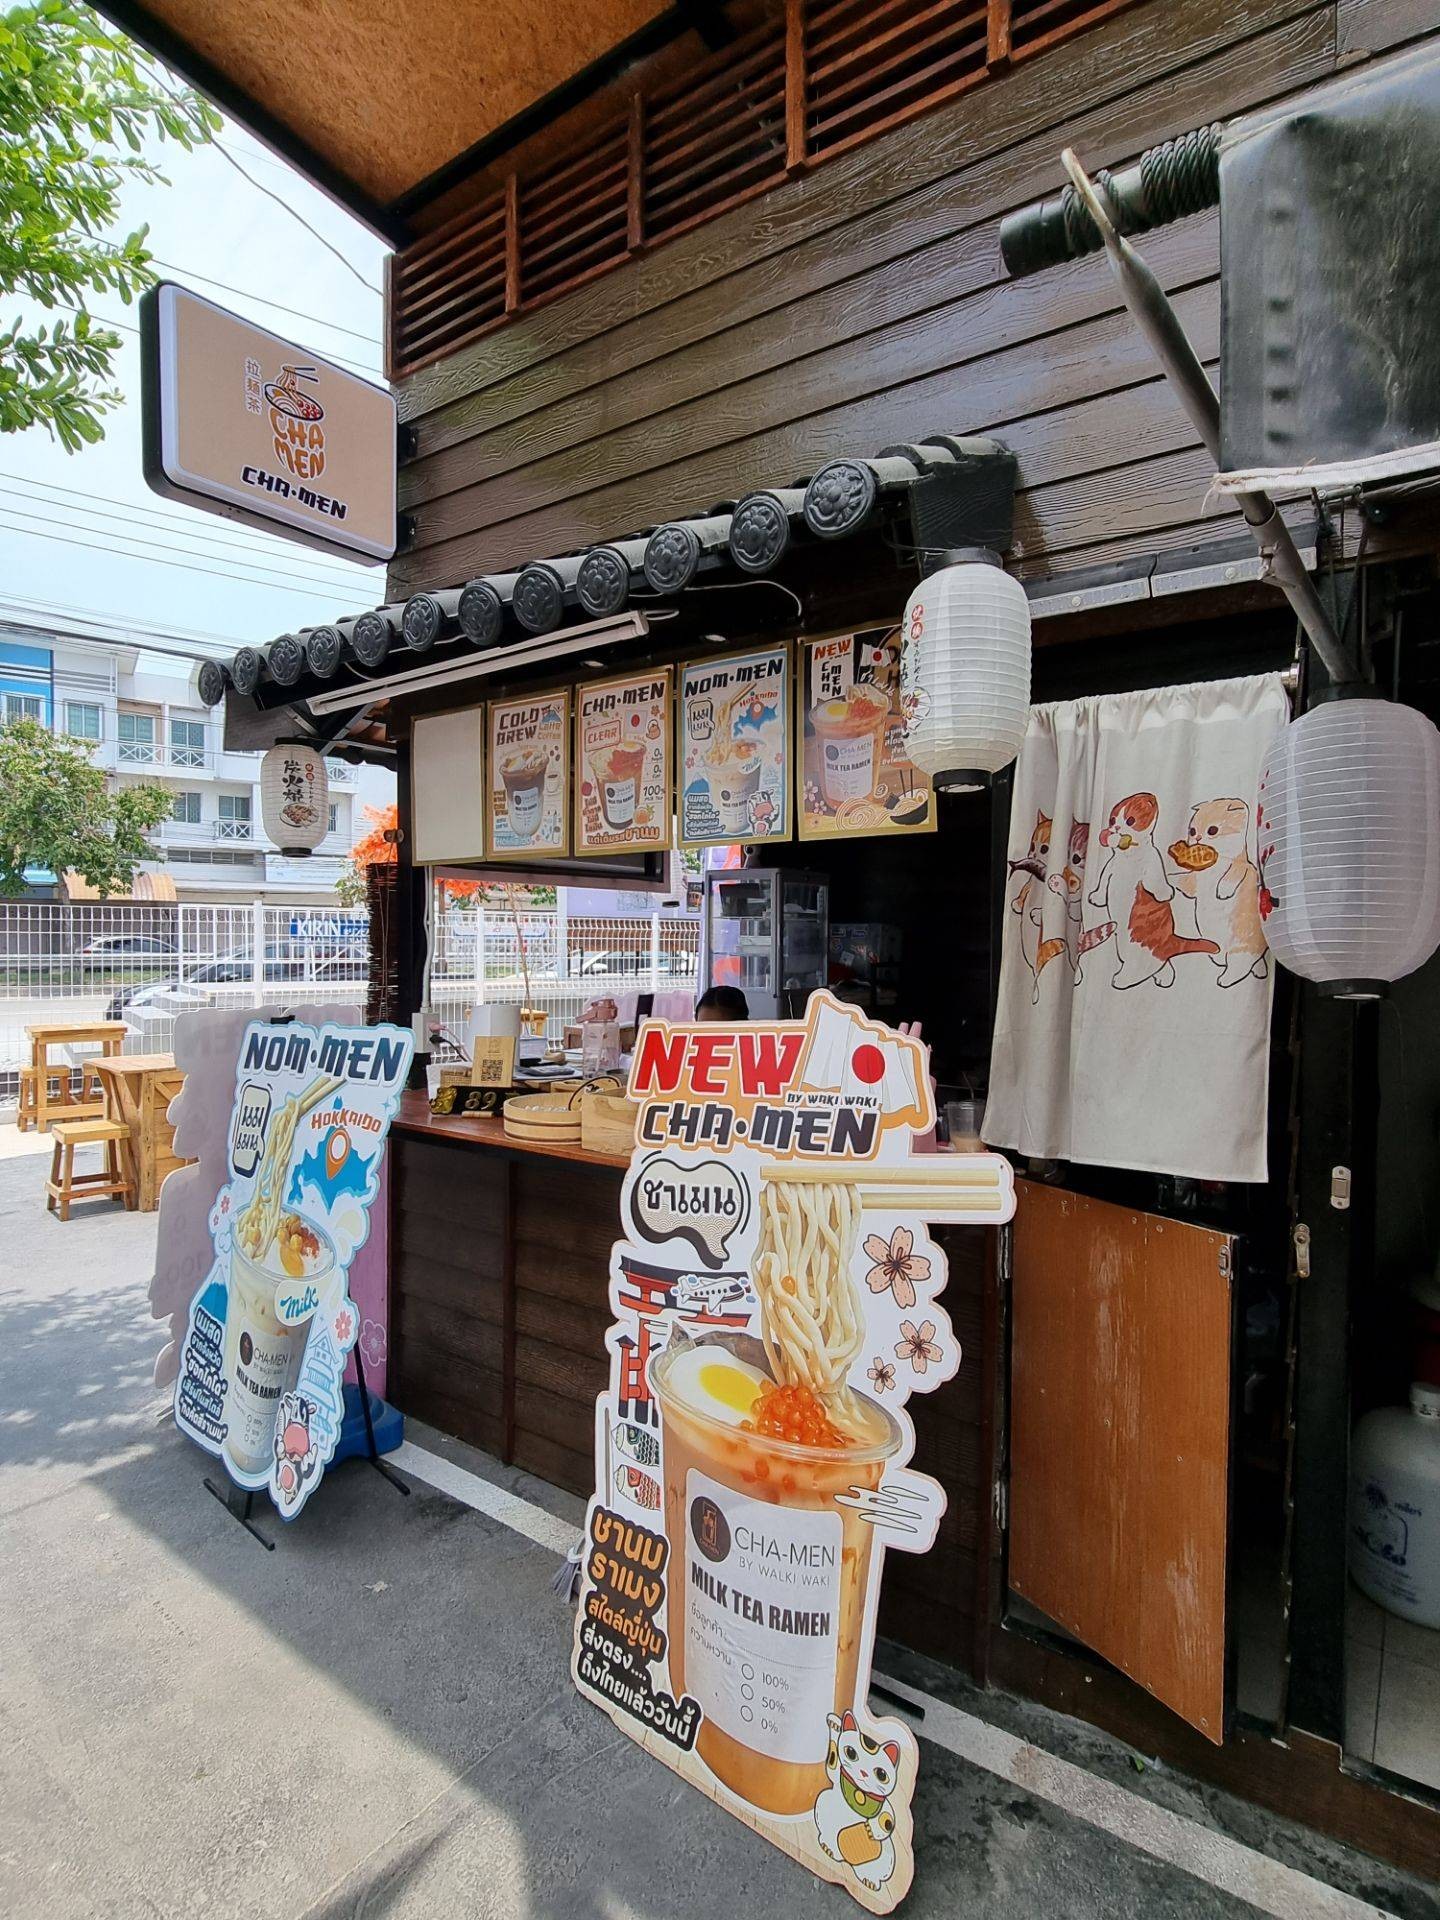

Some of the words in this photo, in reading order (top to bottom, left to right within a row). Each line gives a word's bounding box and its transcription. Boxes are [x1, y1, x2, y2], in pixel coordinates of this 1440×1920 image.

[270, 408, 324, 450] CHA
[273, 437, 325, 479] MEN
[814, 639, 852, 660] NEW
[499, 707, 541, 731] COLD
[496, 725, 538, 747] BREW
[587, 728, 618, 745] CLEAR
[297, 919, 341, 936] KIRIN
[634, 1030, 806, 1095] NEW
[787, 1093, 802, 1103] BY
[808, 1094, 839, 1105] WAKI
[844, 1097, 877, 1107] WAKI
[311, 1108, 382, 1133] HOKKAIDO
[594, 1512, 664, 1571] ชานม
[734, 1526, 835, 1568] CHA-MEN
[591, 1552, 661, 1608] ราเมง
[739, 1556, 753, 1571] BY
[802, 1575, 830, 1588] WAKI
[691, 1561, 728, 1609] MILK
[731, 1588, 765, 1626] TEA
[768, 1604, 831, 1637] RAMEN
[588, 1593, 662, 1657] สไตล์ญี่ปุ่น
[762, 1672, 790, 1692] 100%
[581, 1654, 696, 1743] ถึงไทยแล้ววันนี้
[761, 1697, 787, 1713] 50%
[761, 1718, 779, 1734] 0%
